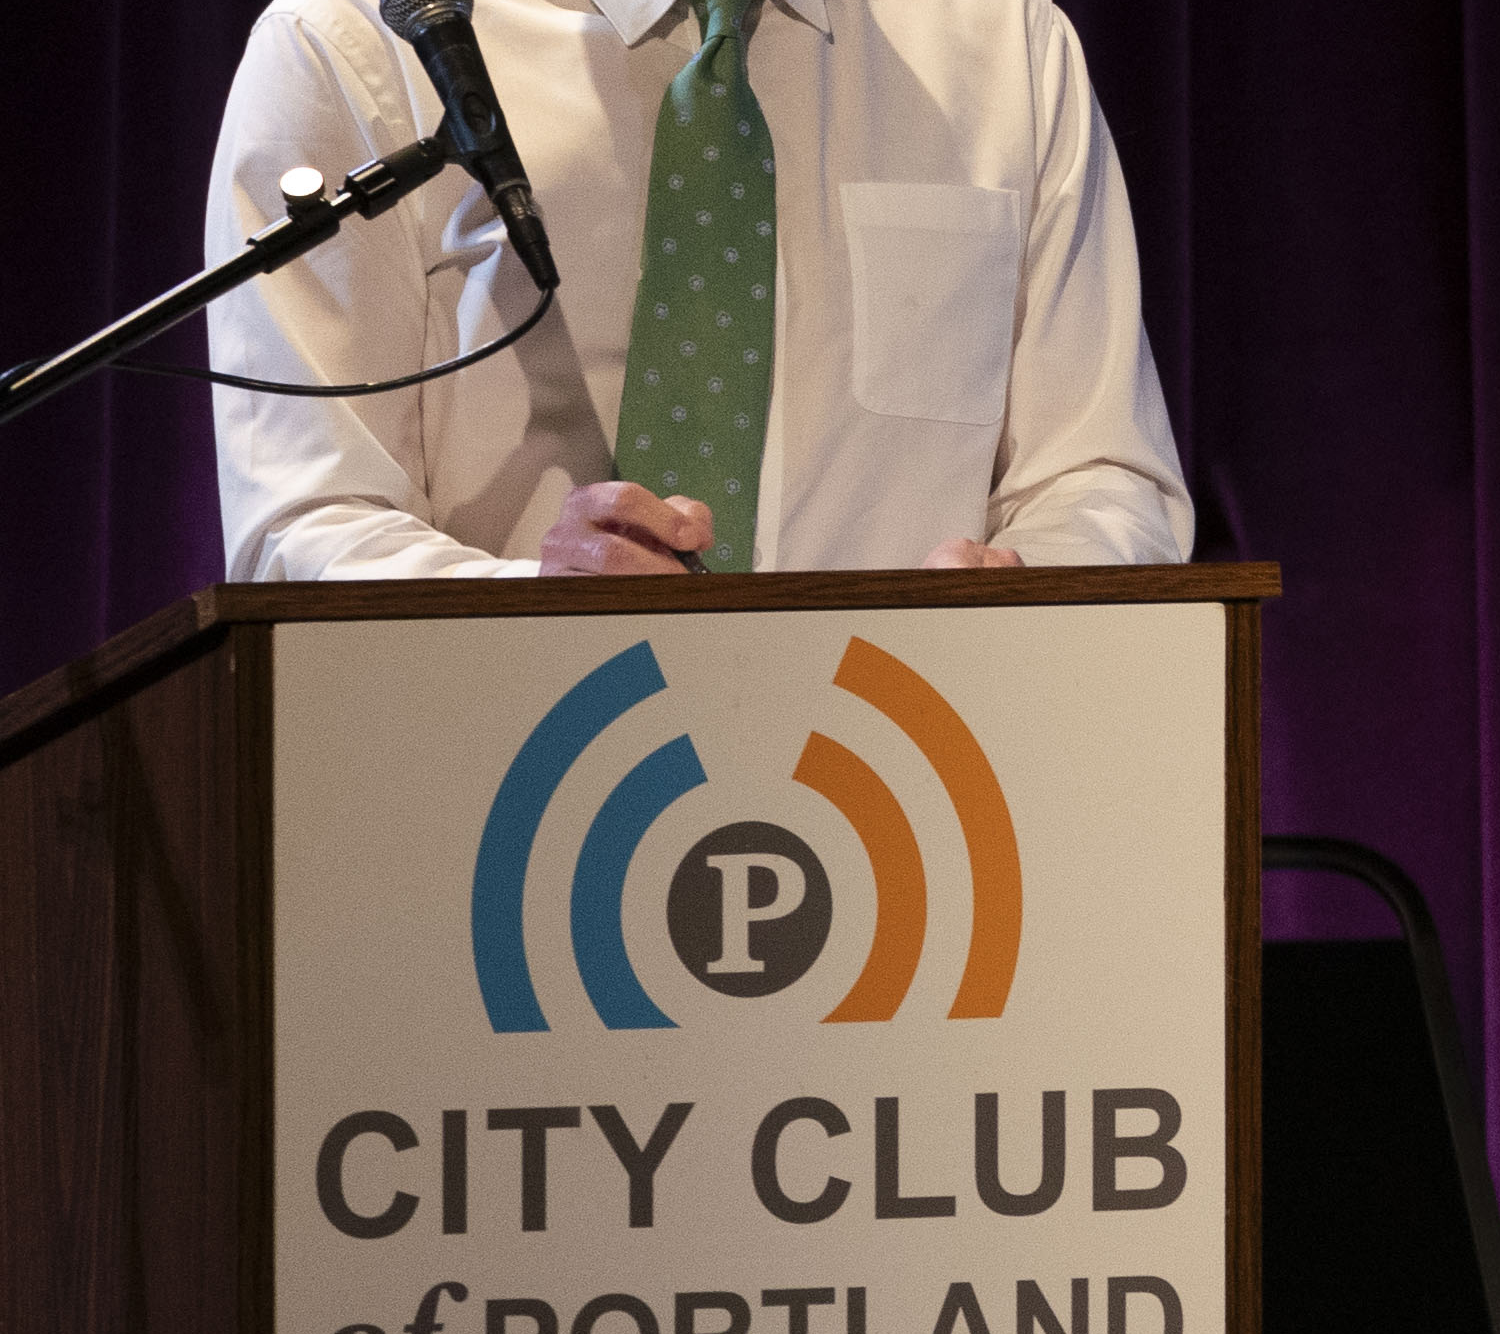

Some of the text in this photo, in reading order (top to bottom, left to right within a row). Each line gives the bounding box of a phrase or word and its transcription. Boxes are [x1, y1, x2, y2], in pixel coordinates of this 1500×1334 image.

[705, 852, 807, 974] P
[315, 1087, 1189, 1239] CITY CLUB
